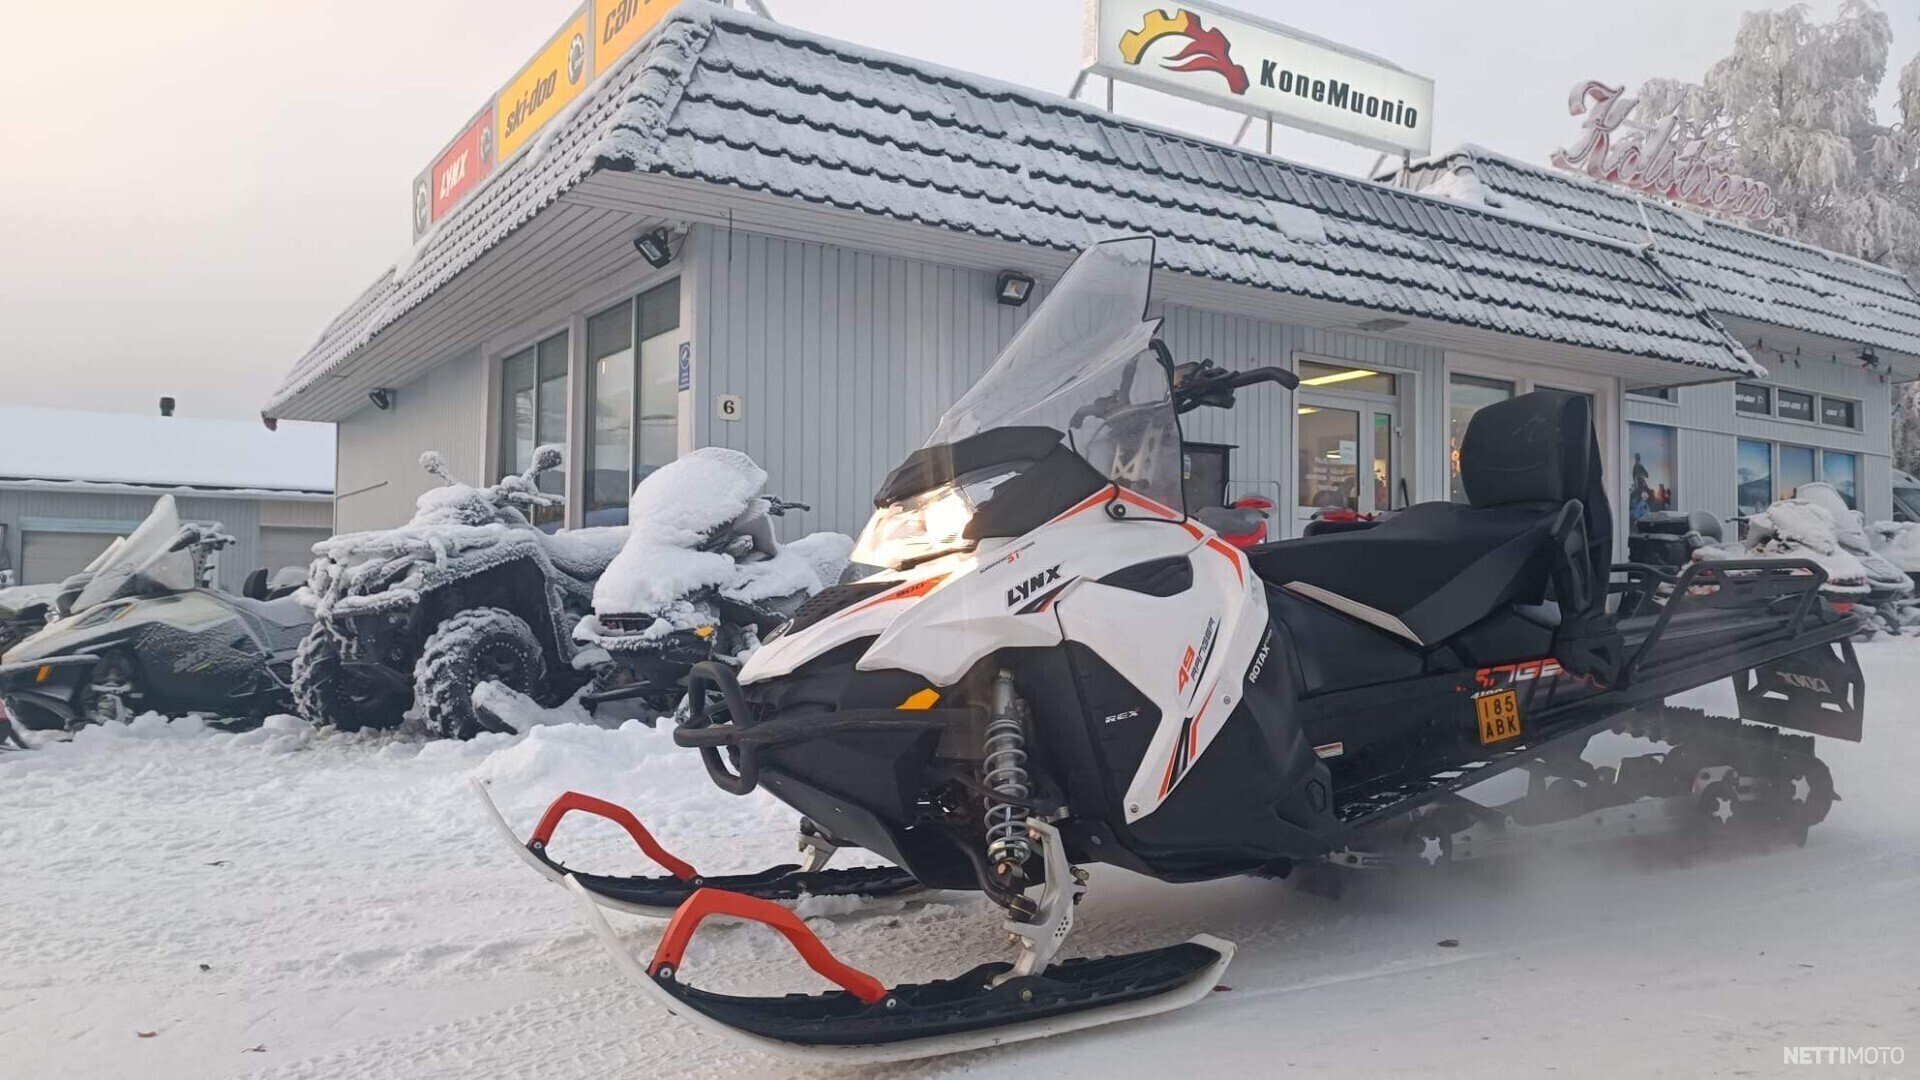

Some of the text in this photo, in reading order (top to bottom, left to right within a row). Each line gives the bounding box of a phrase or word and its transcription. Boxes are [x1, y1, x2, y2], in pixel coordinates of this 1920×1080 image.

[505, 69, 558, 138] ski-doo
[1260, 59, 1418, 129] KoneMuonio
[440, 148, 469, 200] LYNX
[723, 400, 735, 415] 6
[1007, 564, 1062, 608] LYNX
[1179, 645, 1196, 695] 49
[1190, 616, 1216, 682] RANGER
[1248, 643, 1271, 684] ROTAX
[1483, 695, 1515, 718] 185
[1485, 714, 1517, 739] ABK
